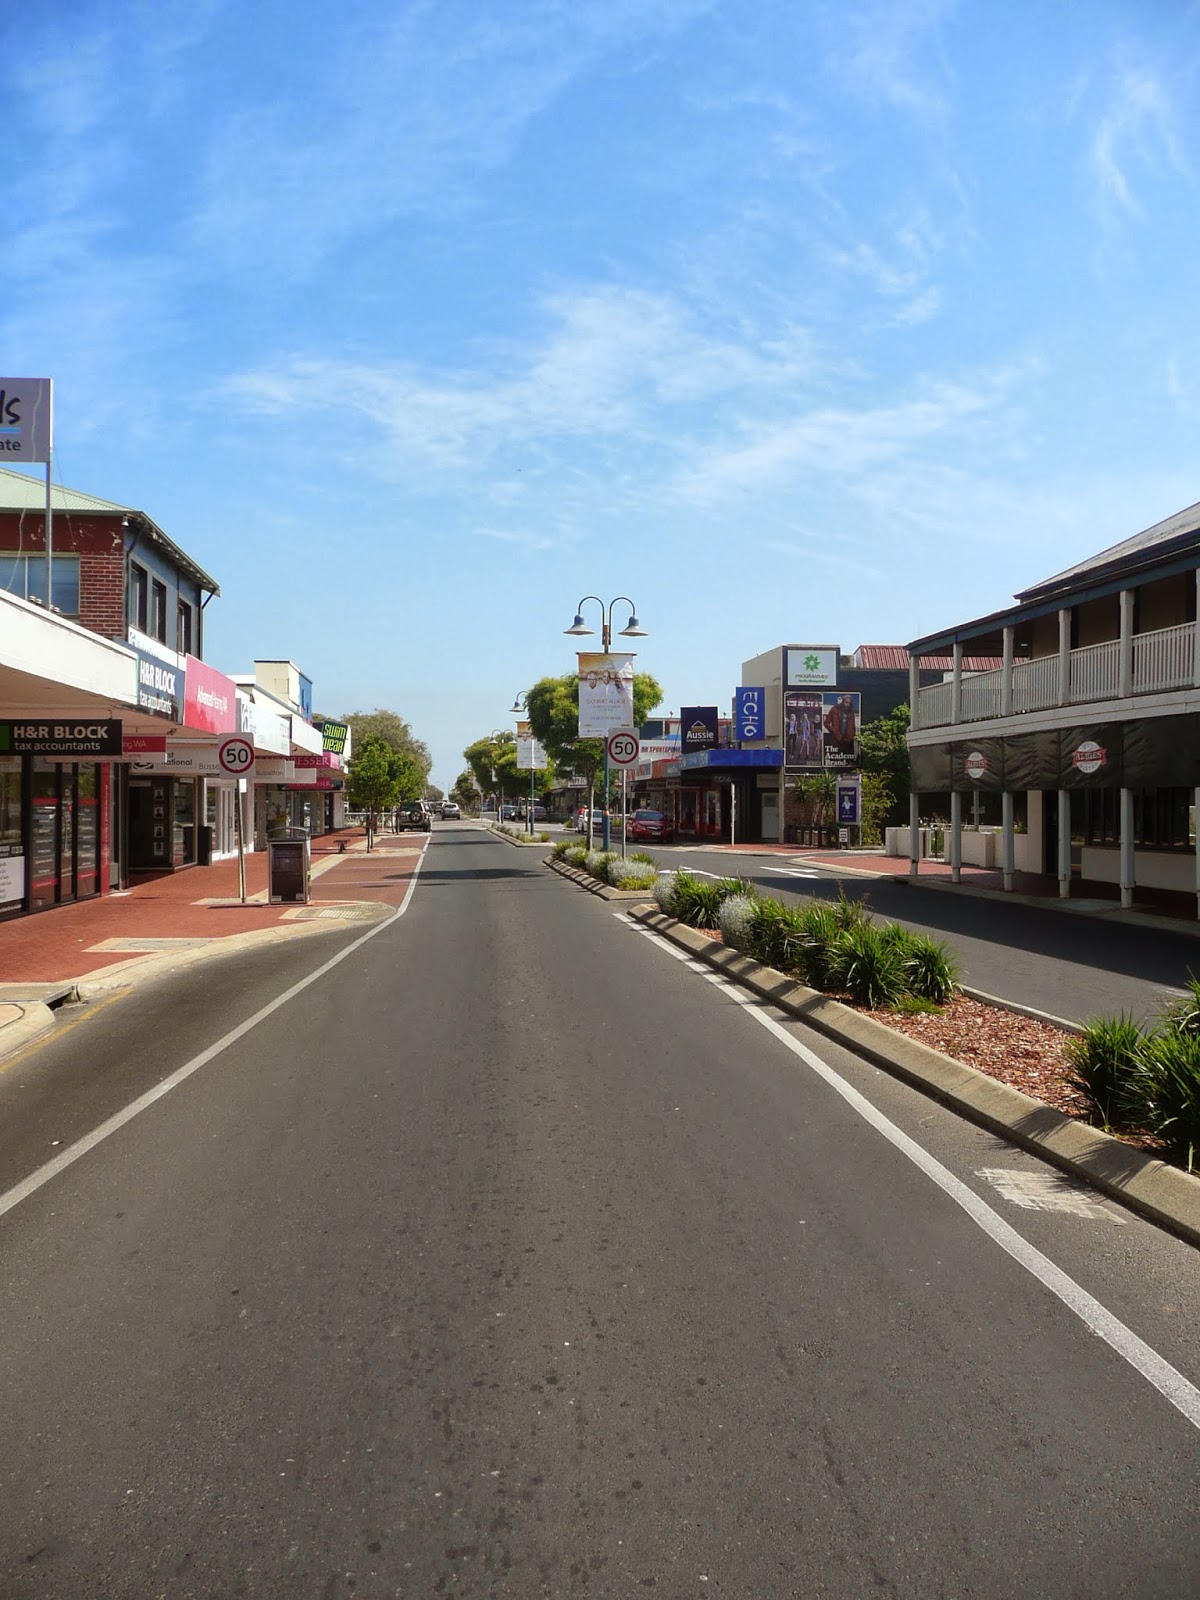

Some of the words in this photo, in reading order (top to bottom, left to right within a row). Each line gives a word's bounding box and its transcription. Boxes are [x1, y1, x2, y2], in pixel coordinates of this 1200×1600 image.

[140, 660, 154, 689] H&R
[155, 667, 176, 695] BLOCK
[742, 691, 759, 737] ECHO
[13, 726, 49, 739] H&R
[54, 726, 109, 739] BLOCK
[686, 730, 714, 739] Aussie
[14, 742, 31, 751] tax
[34, 741, 101, 751] accountants
[133, 739, 147, 748] WA
[614, 741, 635, 756] 50
[825, 745, 839, 753] The
[226, 748, 248, 764] 50
[824, 752, 857, 762] Academy
